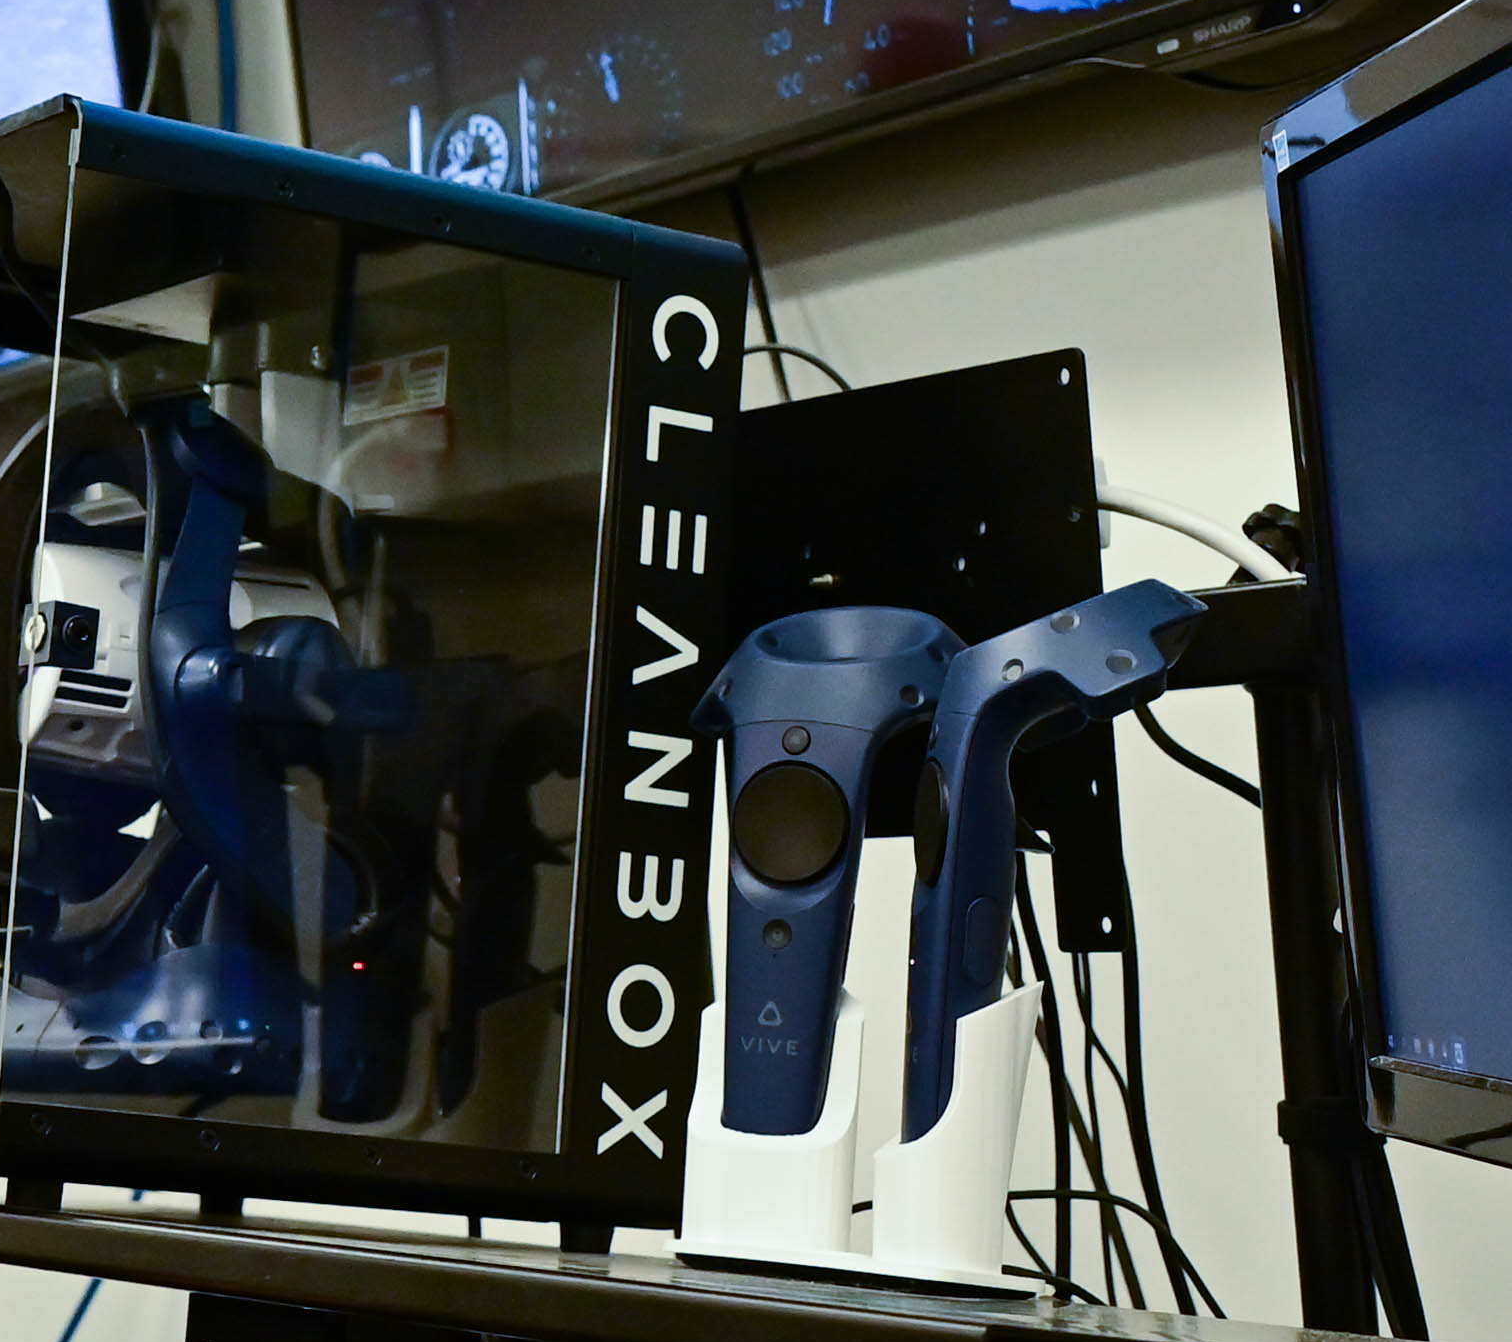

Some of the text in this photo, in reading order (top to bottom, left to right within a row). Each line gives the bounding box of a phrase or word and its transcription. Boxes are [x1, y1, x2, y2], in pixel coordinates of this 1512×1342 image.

[1192, 15, 1253, 44] SHARP
[597, 293, 720, 1161] CLEANBOX
[740, 1035, 800, 1057] VIVE
